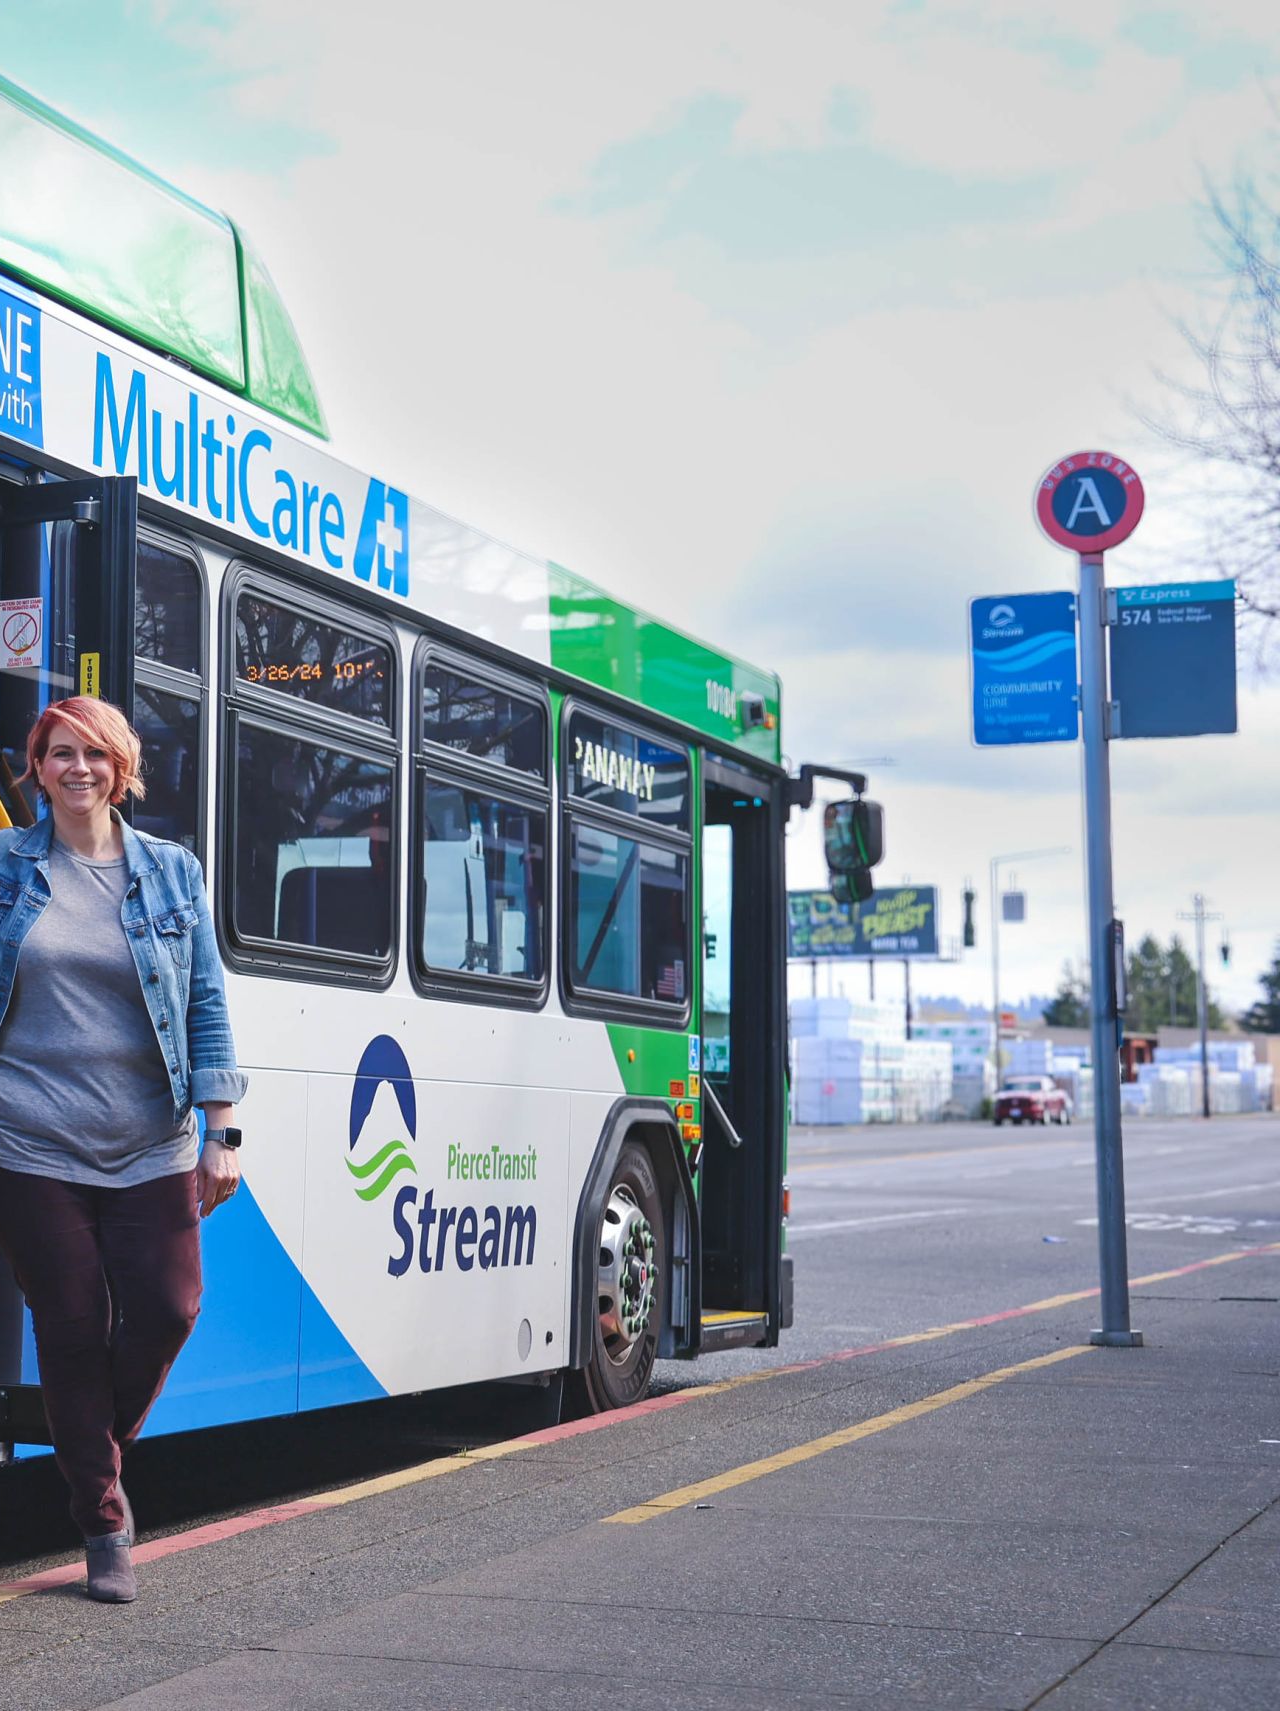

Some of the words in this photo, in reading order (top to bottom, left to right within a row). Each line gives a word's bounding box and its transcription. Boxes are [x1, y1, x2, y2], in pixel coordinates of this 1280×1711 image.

[93, 352, 345, 569] MultiCare
[1043, 459, 1075, 490] BUS
[1087, 452, 1137, 484] ZONE
[1065, 477, 1112, 529] A
[1140, 589, 1191, 603] Express
[1122, 609, 1152, 626] 574
[246, 663, 322, 681] 3/26/24
[447, 1142, 537, 1180] PierceTransit
[387, 1185, 537, 1278] Stream
